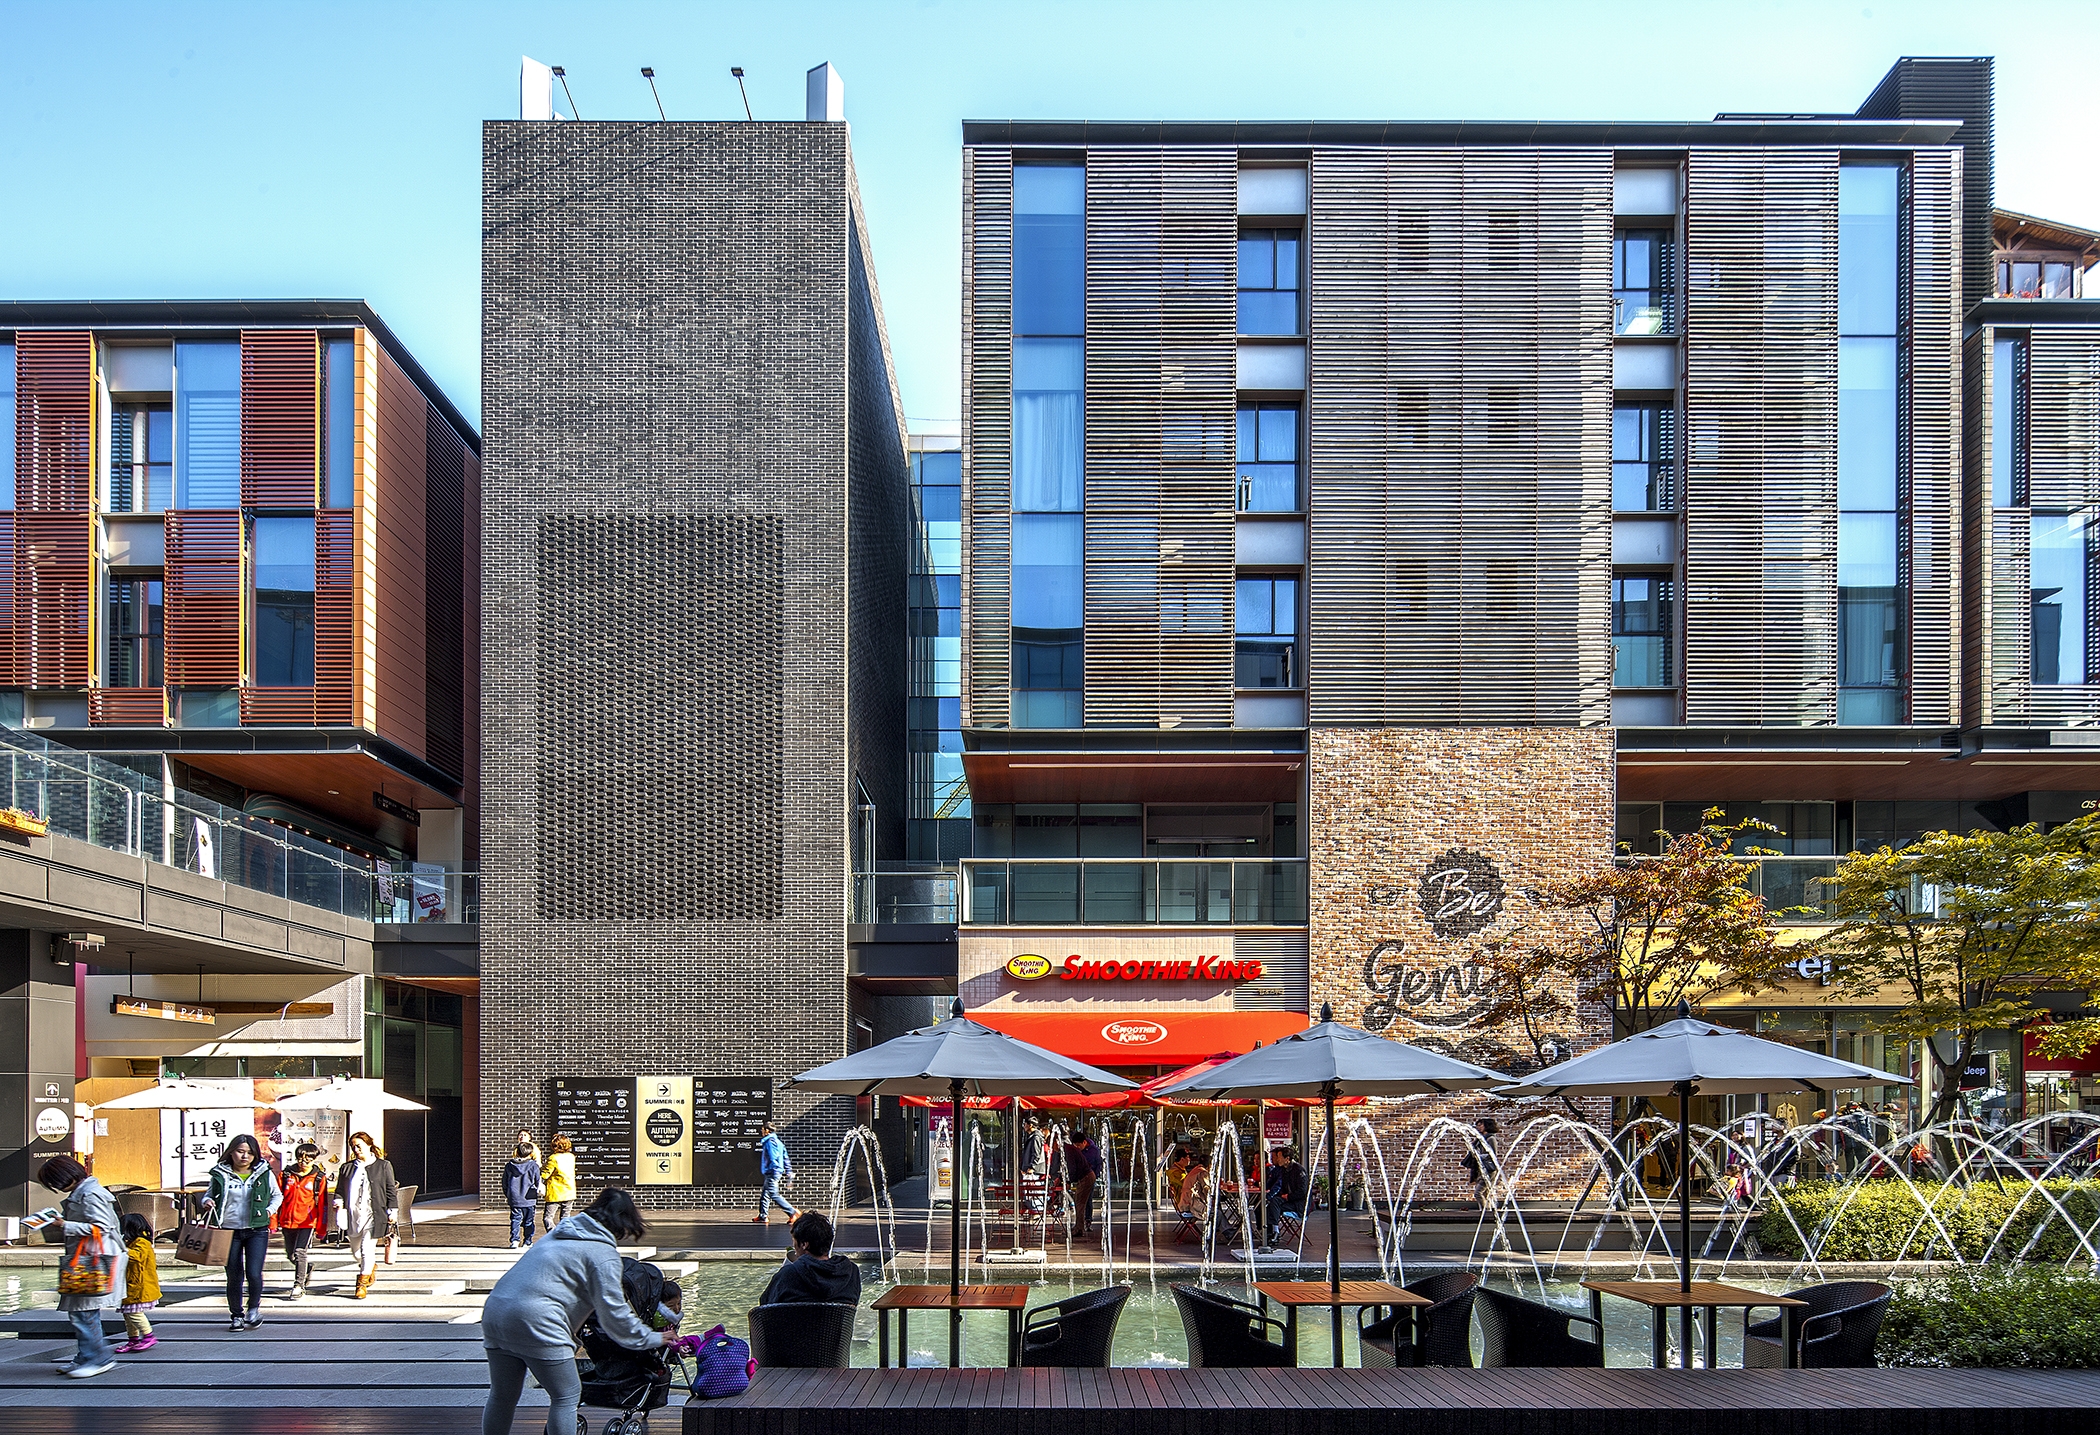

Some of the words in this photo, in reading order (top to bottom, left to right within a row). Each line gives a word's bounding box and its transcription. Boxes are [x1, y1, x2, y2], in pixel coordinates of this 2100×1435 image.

[1429, 868, 1497, 918] Be
[1012, 958, 1045, 968] SMOOTHIE
[1060, 955, 1192, 980] SMOOTHIE
[1192, 955, 1263, 980] KING
[1019, 966, 1040, 975] KING
[1110, 1024, 1157, 1035] SMOOTHIE
[1118, 1032, 1149, 1043] KING
[1963, 1066, 1987, 1077] Jeep
[967, 1095, 991, 1104] KING
[188, 1119, 228, 1138] 11월
[650, 1127, 679, 1135] AUTUMN
